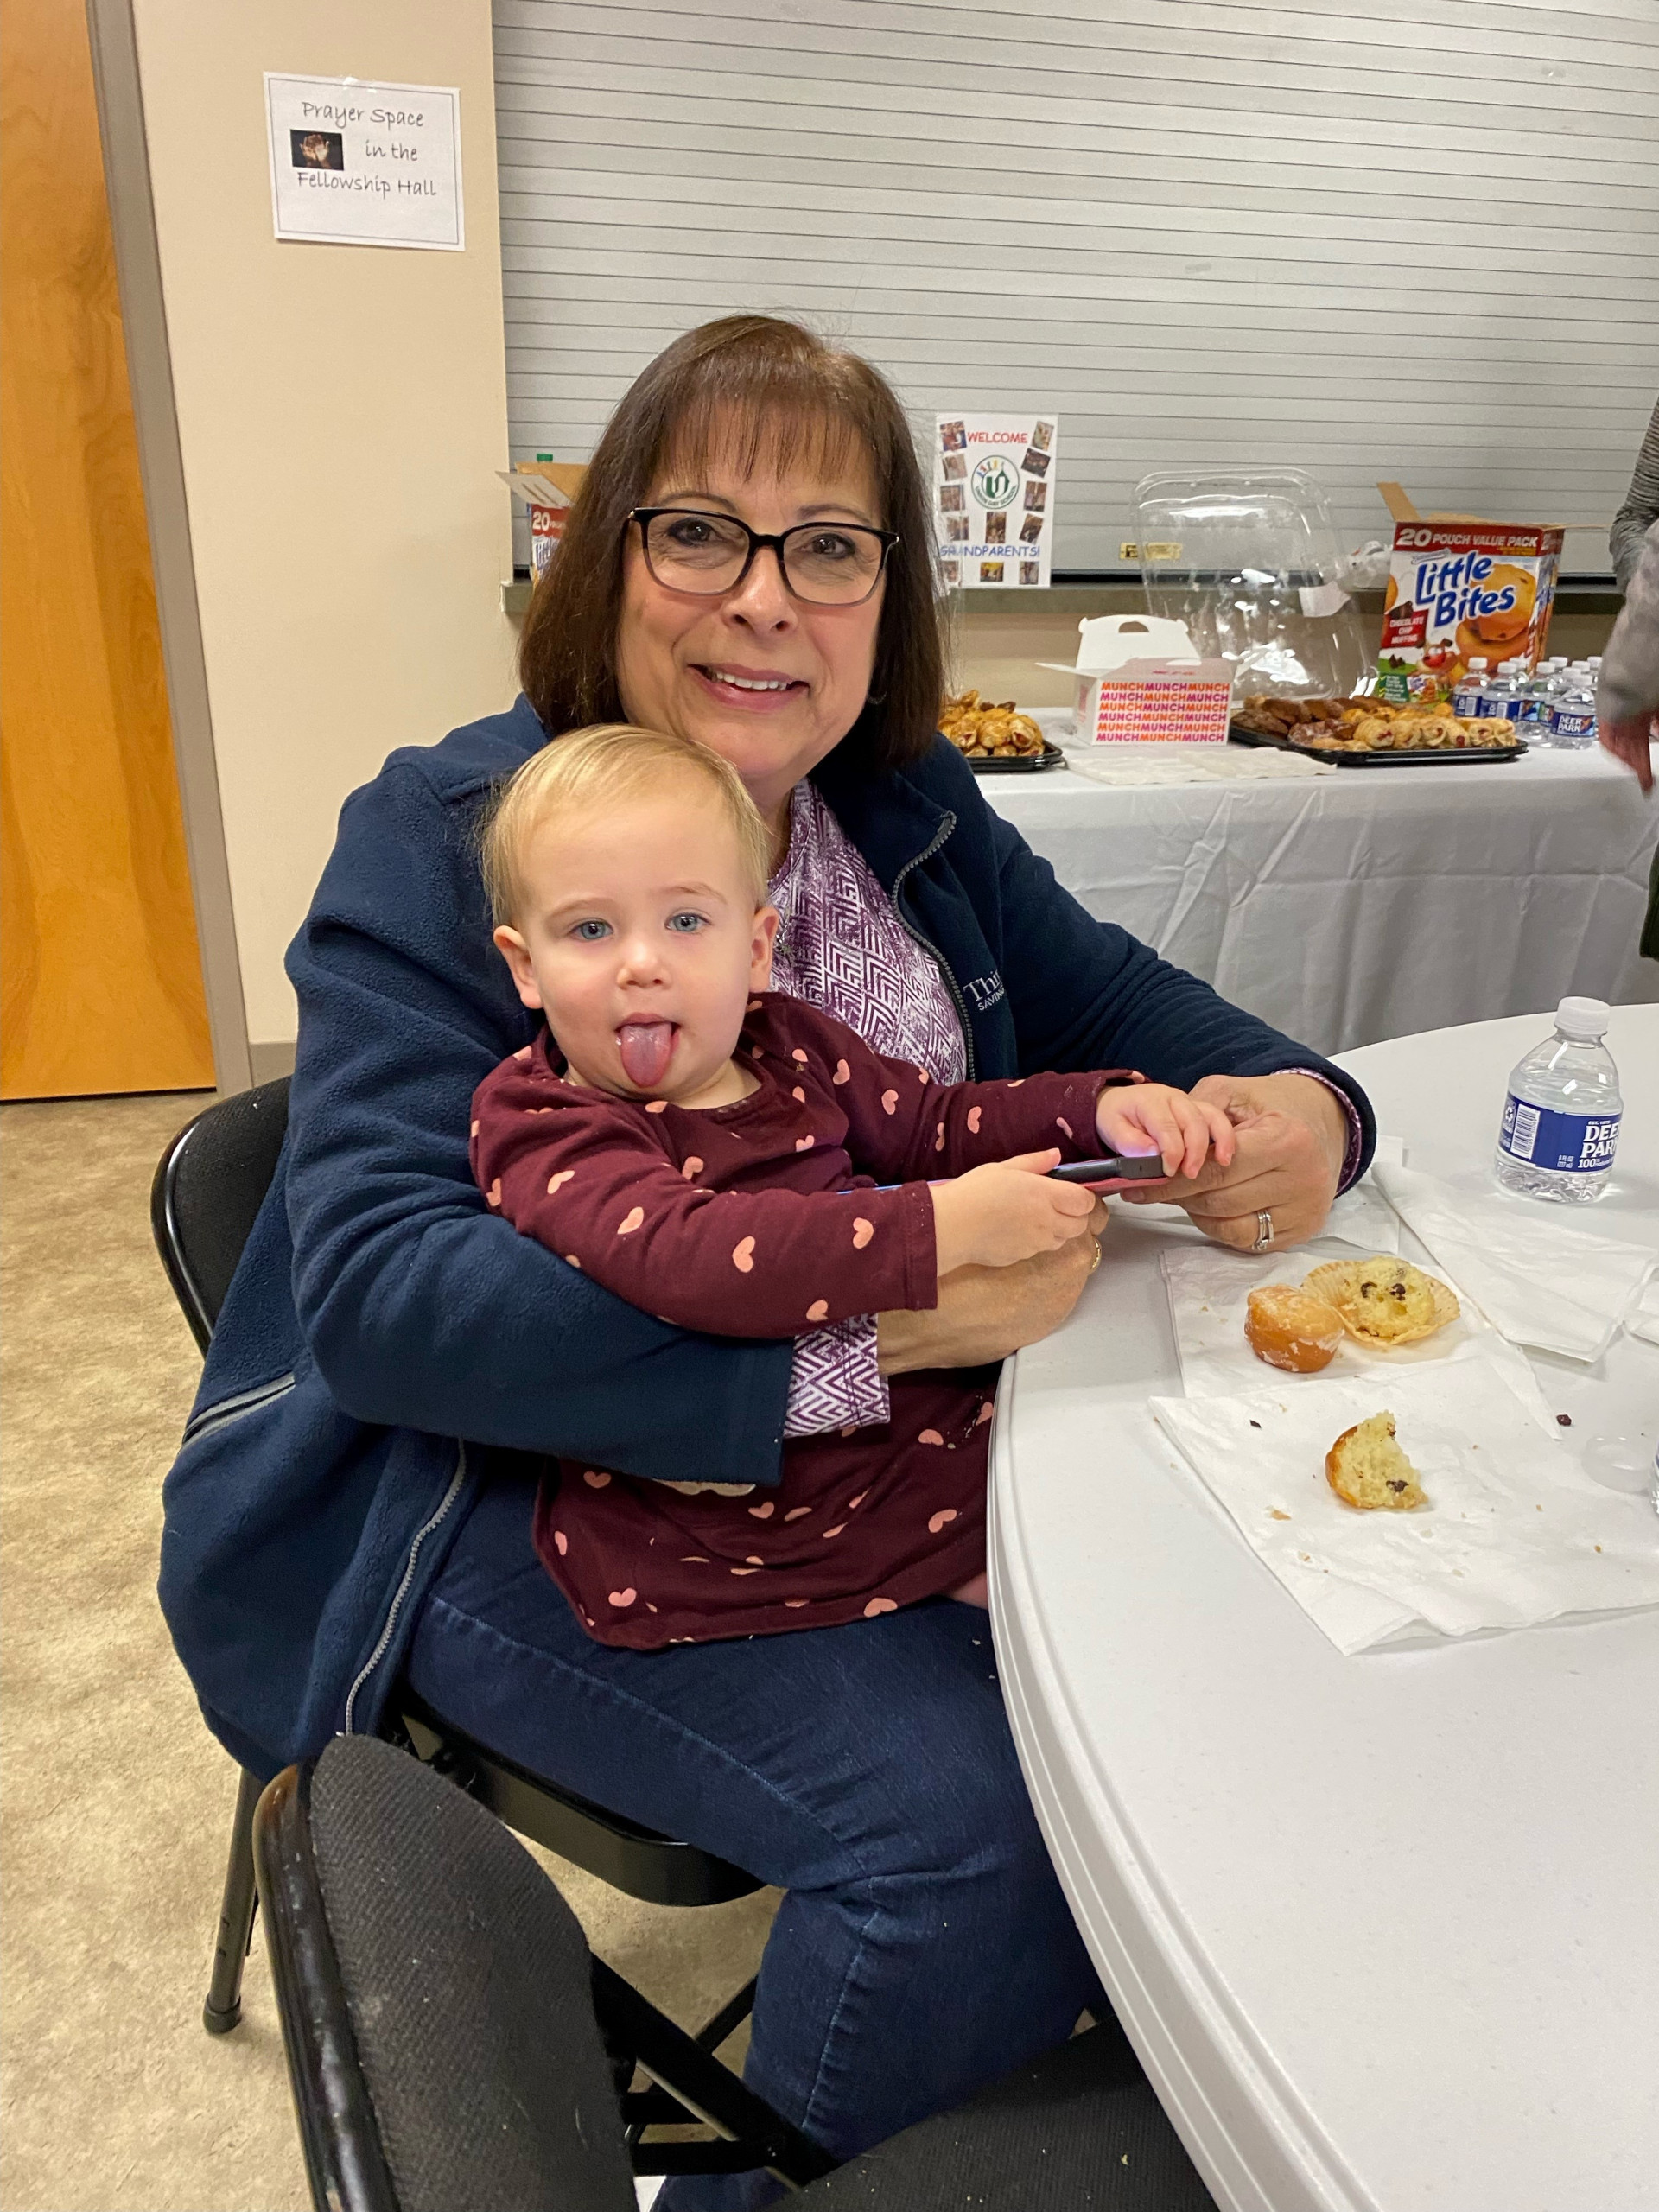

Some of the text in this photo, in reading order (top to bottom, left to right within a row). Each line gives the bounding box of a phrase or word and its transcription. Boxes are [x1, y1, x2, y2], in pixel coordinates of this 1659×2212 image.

[302, 101, 423, 130] Prayer Space
[365, 140, 418, 162] in the
[297, 171, 437, 200] Fellowship Hall
[968, 431, 1028, 443] WELCOME
[532, 511, 550, 531] 20
[1395, 528, 1432, 547] 20
[1432, 533, 1469, 546] POUCH
[1472, 534, 1505, 546] VALUE
[1507, 536, 1538, 548] PACK
[1415, 551, 1492, 606] Little
[1434, 586, 1515, 627] Bites
[1558, 723, 1581, 733] PARK
[1560, 715, 1583, 726] DEER
[1583, 1122, 1619, 1141] DEE
[1580, 1140, 1616, 1159] PAR
